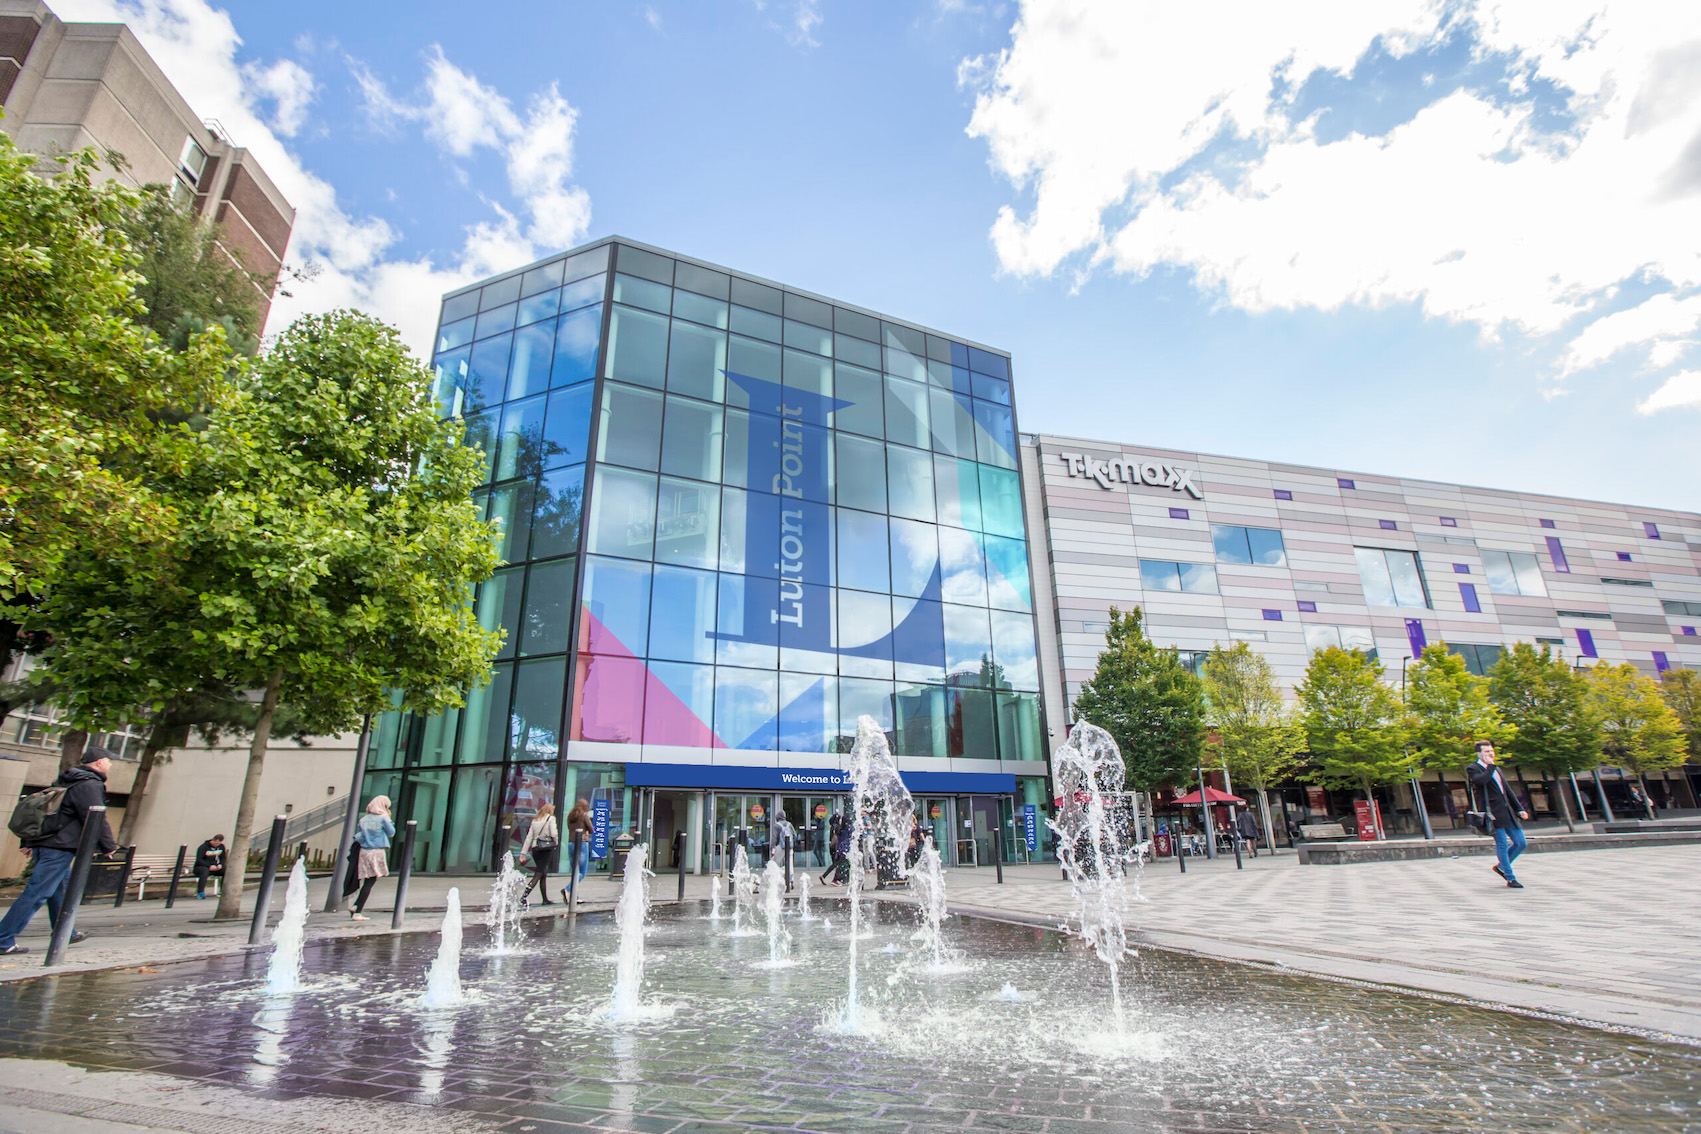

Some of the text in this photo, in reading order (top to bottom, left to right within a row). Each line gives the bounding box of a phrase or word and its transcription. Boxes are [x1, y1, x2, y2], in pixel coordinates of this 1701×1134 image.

[771, 403, 804, 628] Luton Point
[782, 773, 828, 784] Welcome
[830, 775, 841, 785] to
